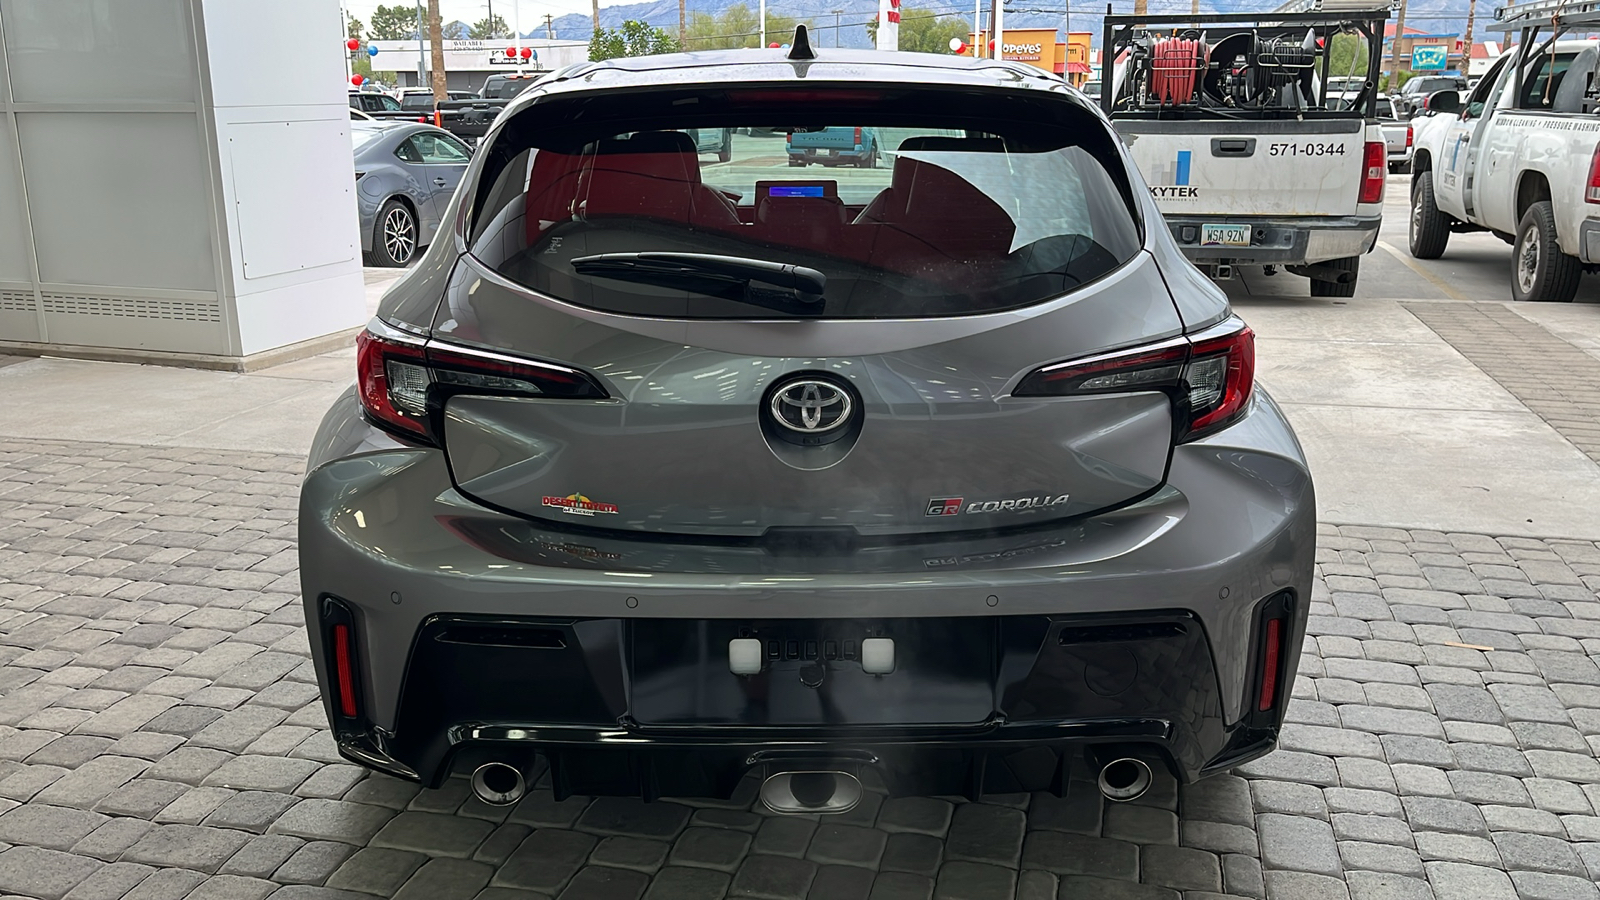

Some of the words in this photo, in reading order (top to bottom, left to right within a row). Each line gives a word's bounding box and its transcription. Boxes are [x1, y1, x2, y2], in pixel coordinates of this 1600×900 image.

[1513, 119, 1537, 127] CLEANING
[1543, 120, 1572, 130] PRESSURE
[1573, 122, 1600, 132] WASHING
[1269, 143, 1345, 156] 571-0344
[1149, 186, 1199, 197] KYTEK
[1207, 229, 1224, 242] WSA
[1227, 229, 1244, 243] 9ZN
[542, 496, 577, 507] DESERT
[579, 500, 618, 513] TOYOTA
[928, 505, 958, 515] GR
[966, 494, 1069, 514] COROLLA
